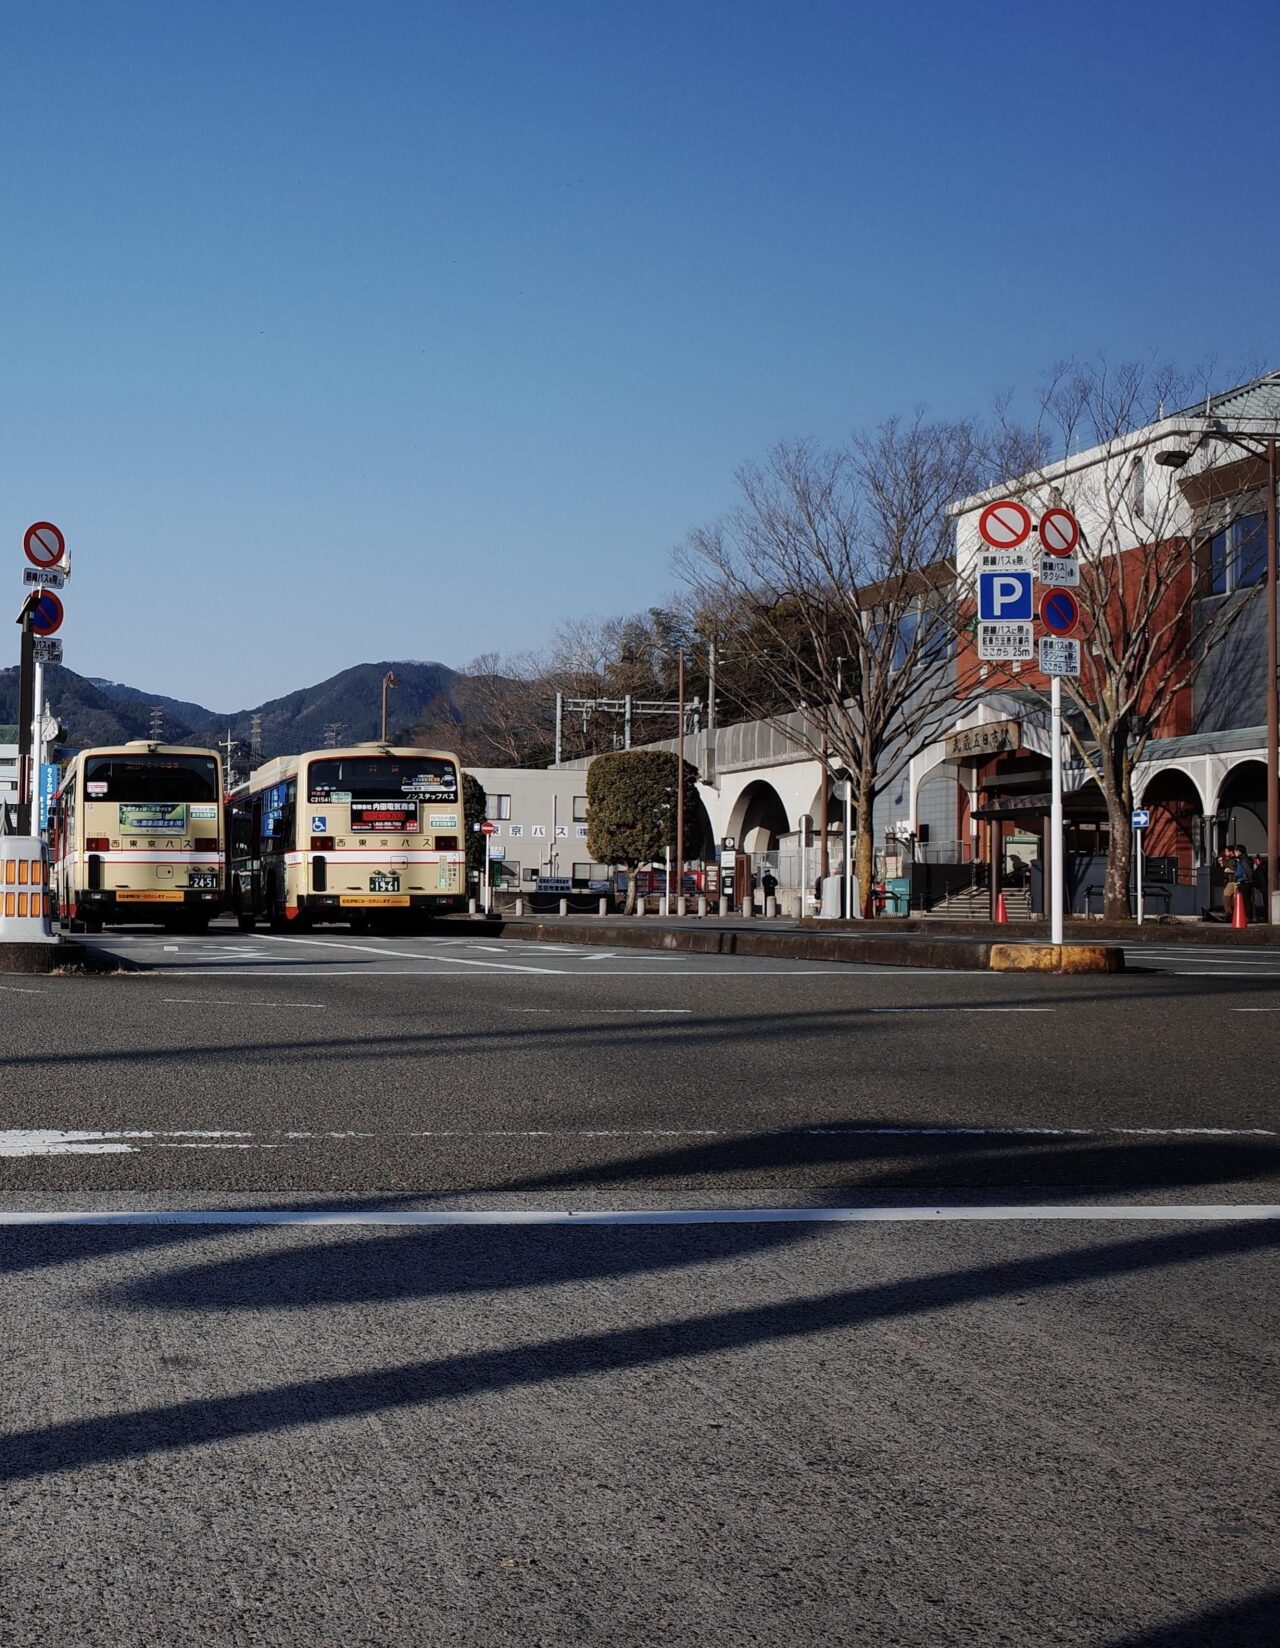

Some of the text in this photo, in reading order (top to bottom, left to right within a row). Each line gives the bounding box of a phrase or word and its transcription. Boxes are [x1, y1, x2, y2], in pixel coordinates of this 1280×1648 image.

[983, 555, 1029, 566] 路線バスを除く
[1042, 571, 1065, 582] タクシー
[993, 576, 1023, 616] P
[983, 625, 1030, 635] 路線バスに限る
[983, 646, 1031, 657] ここから 25m
[1044, 662, 1078, 673] ここから 25m
[110, 839, 193, 849] 西東京バス
[336, 838, 432, 848] 西東京バス
[375, 881, 398, 891] 19-61
